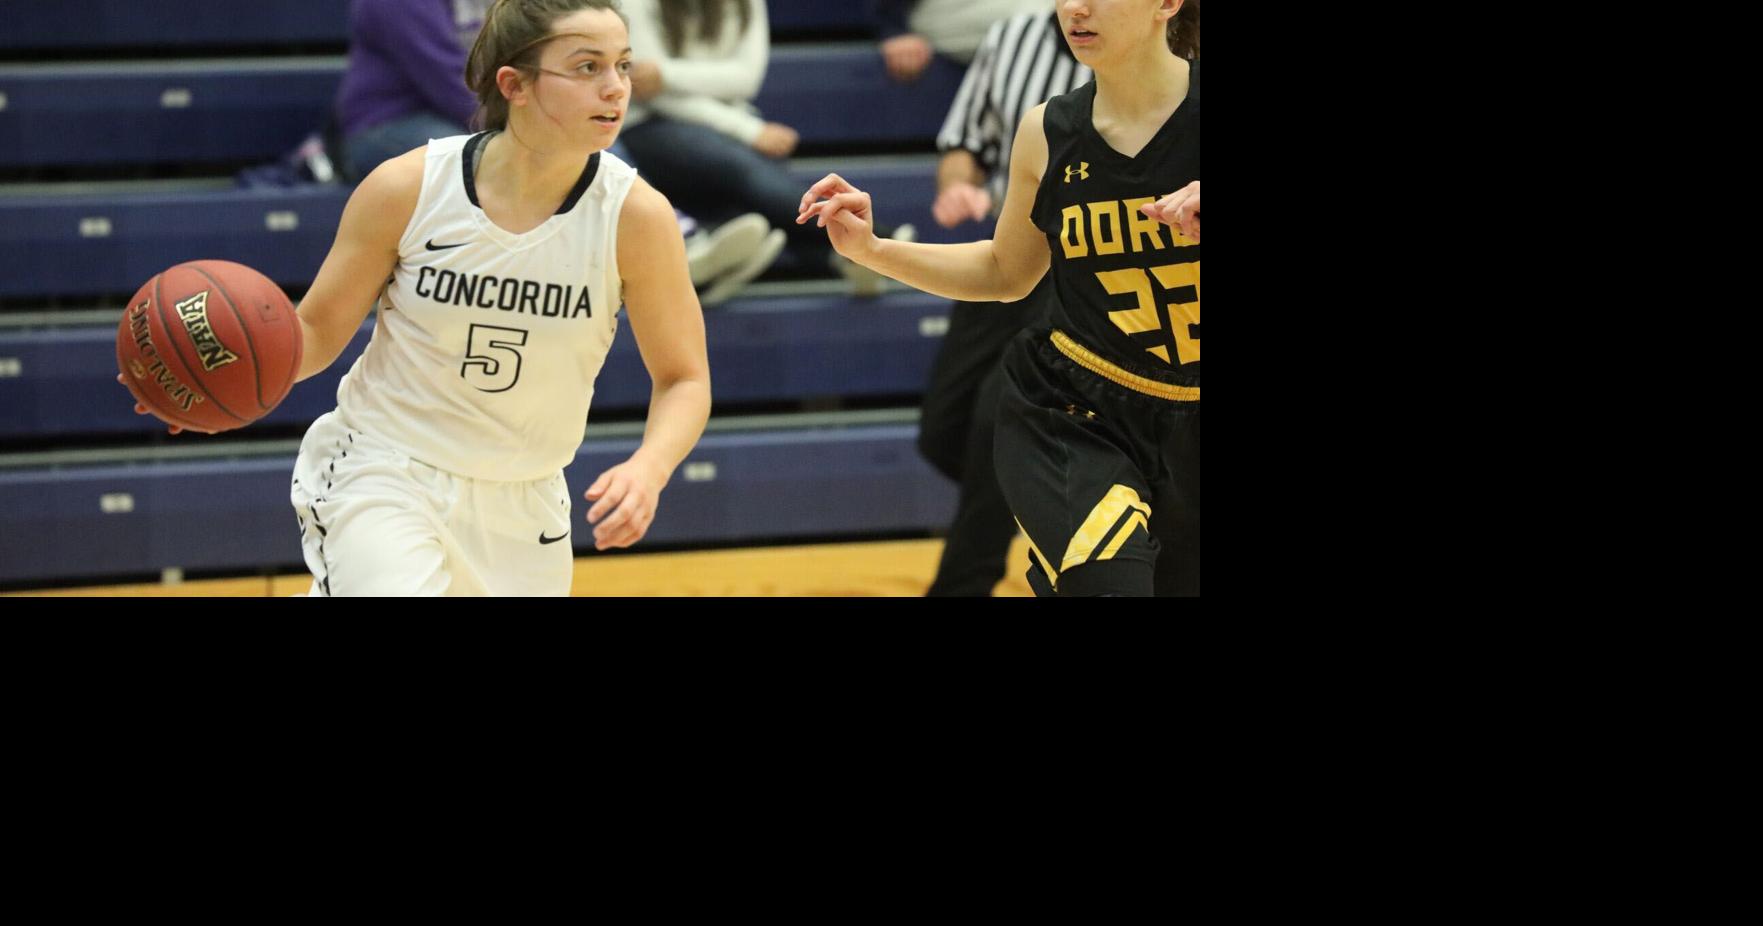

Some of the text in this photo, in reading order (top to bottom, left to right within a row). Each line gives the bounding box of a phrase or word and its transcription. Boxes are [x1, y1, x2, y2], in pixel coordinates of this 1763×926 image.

[1060, 194, 1200, 259] DOR
[415, 265, 592, 319] CONCORDIA
[1094, 260, 1200, 365] 22
[129, 298, 205, 412] SPALDING
[175, 290, 239, 372] NAIA
[460, 323, 529, 393] 5
